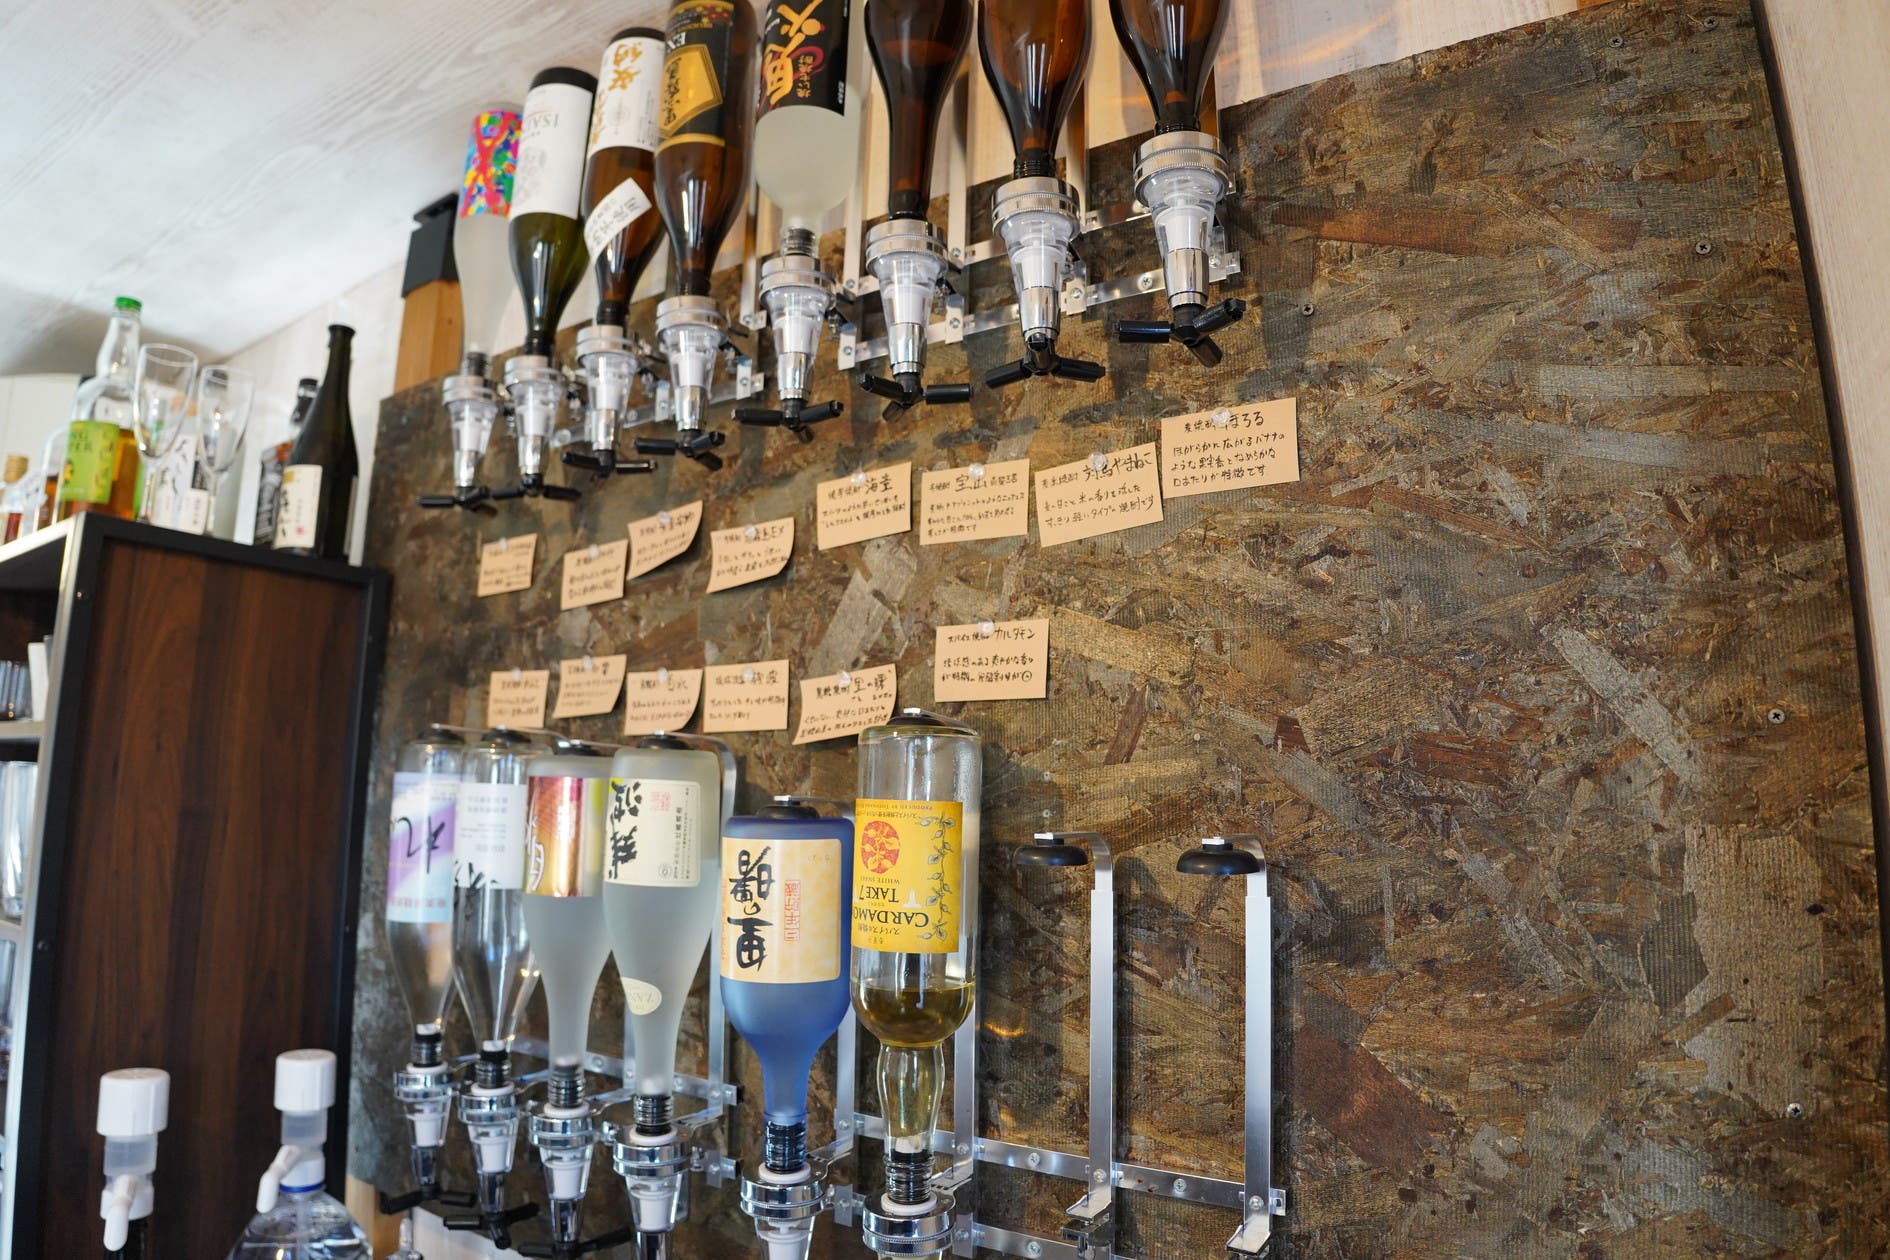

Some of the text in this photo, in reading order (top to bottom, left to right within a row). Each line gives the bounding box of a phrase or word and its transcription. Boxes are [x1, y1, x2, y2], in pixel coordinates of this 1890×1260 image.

[795, 54, 813, 98] 焼いも焼酎
[994, 627, 1036, 641] カルダモン
[726, 846, 776, 973] 里の曙
[783, 879, 801, 942] 三年貯蔵
